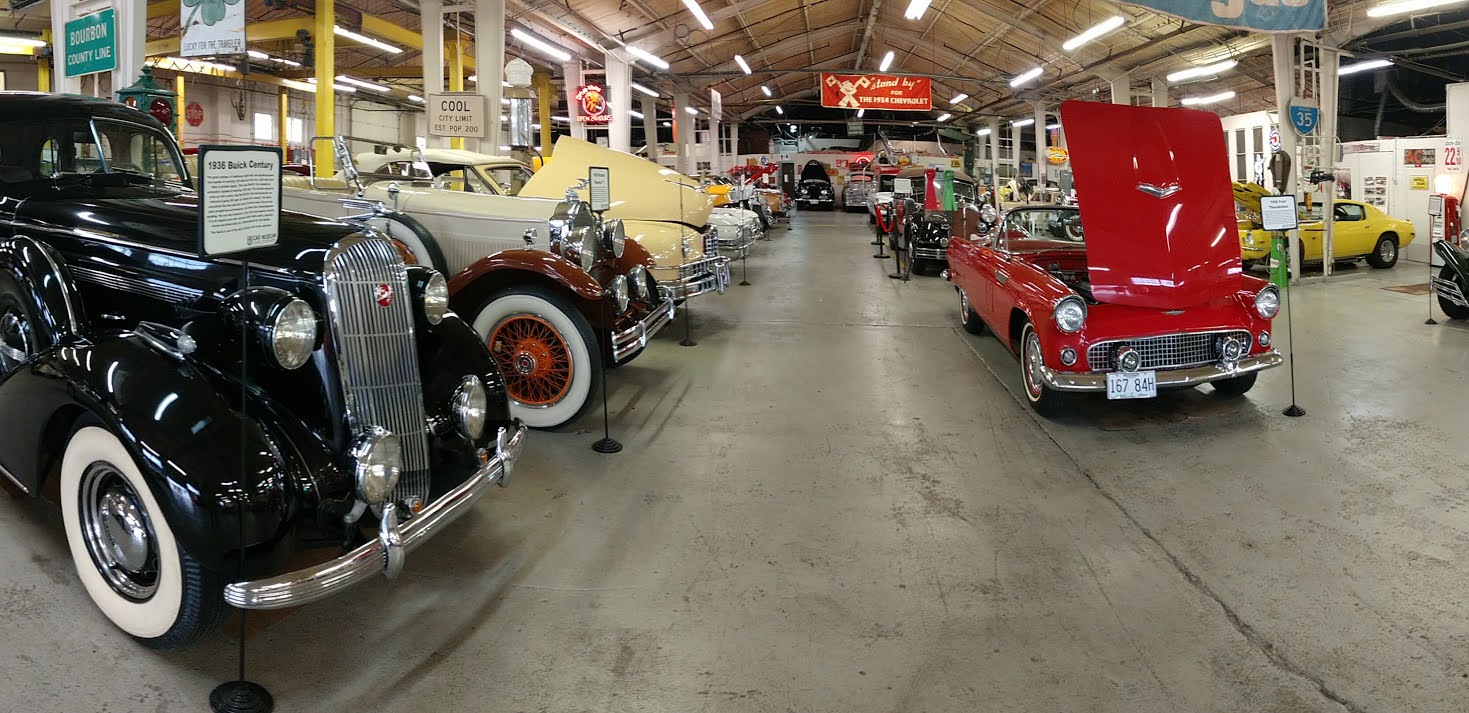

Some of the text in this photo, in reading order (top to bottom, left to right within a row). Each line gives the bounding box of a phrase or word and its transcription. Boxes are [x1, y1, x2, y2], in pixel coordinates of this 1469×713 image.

[70, 22, 107, 46] BOURBON
[207, 40, 217, 49] THE
[68, 47, 111, 66] COUNTY LINE
[186, 108, 203, 119] STOP
[441, 101, 470, 112] COOL
[1296, 112, 1313, 127] 35
[1404, 149, 1424, 164] AC
[1444, 147, 1456, 166] 22
[208, 160, 274, 171] 1936 Buick Century
[1111, 377, 1155, 393] 167 84H
